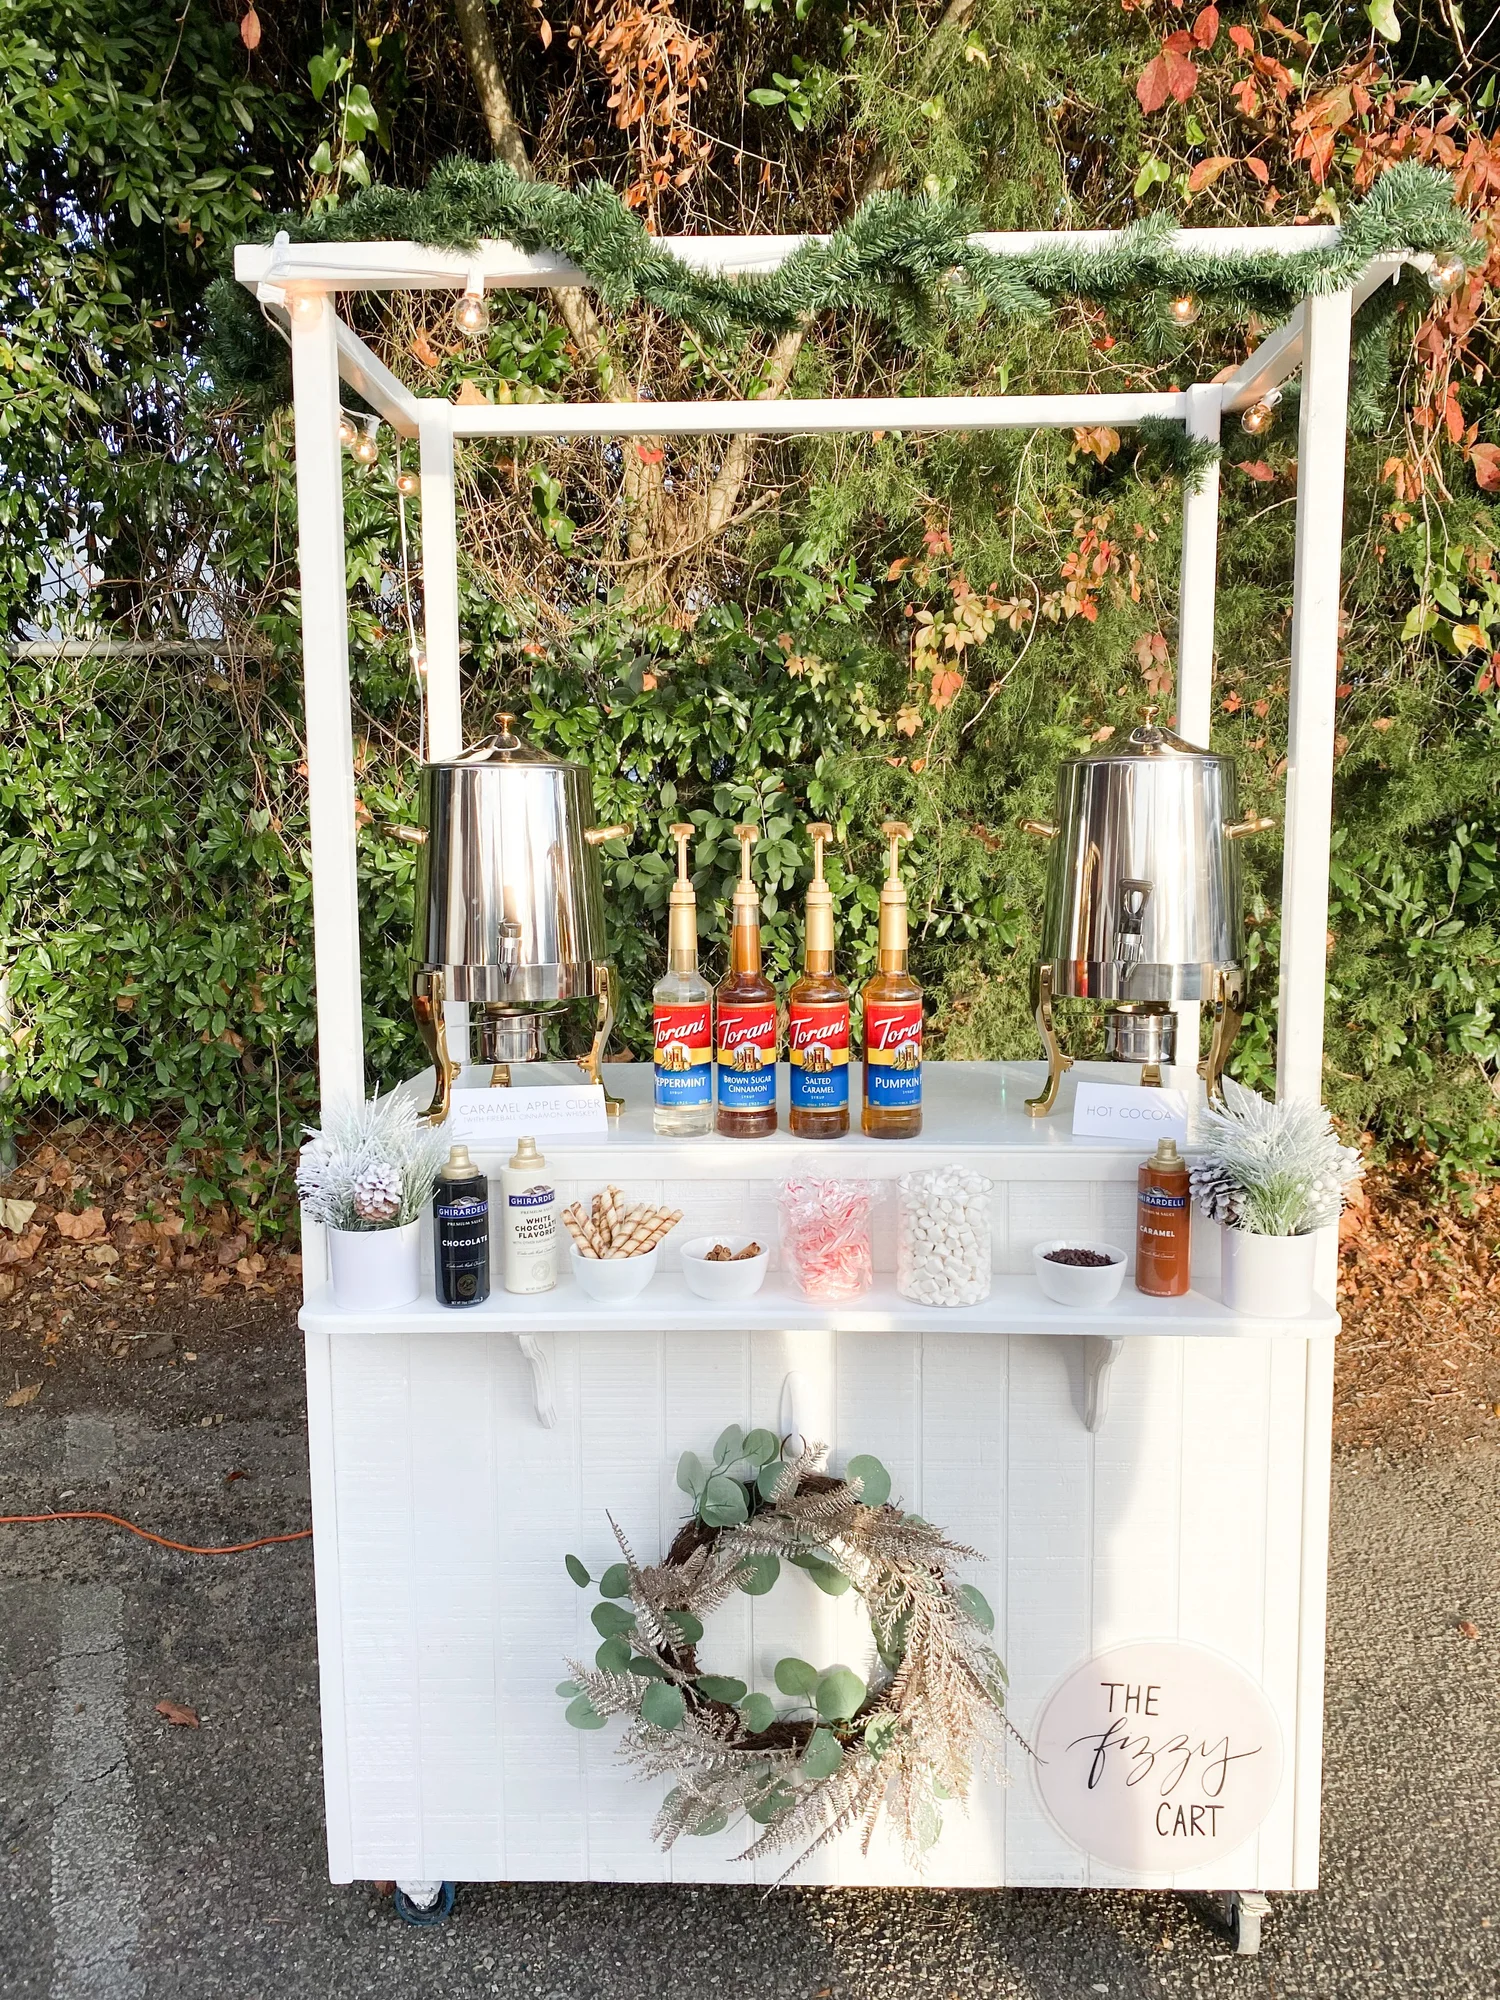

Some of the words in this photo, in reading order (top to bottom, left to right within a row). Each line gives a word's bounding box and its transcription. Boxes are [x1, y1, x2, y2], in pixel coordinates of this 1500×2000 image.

[653, 1014, 706, 1049] Torani
[719, 1014, 774, 1051] Torani
[790, 1014, 846, 1051] Torani
[723, 1075, 749, 1084] BROWN
[750, 1075, 772, 1084] SUGAR
[805, 1076, 831, 1085] SALTED
[875, 1077, 920, 1089] PUMPKIN
[728, 1084, 768, 1093] CINNAMON
[801, 1085, 835, 1093] CARAMEL
[459, 1103, 520, 1116] CARAMEL
[526, 1099, 560, 1111] APPLE
[565, 1098, 601, 1110] CIDER
[1086, 1105, 1113, 1117] HOT
[1119, 1107, 1173, 1121] COCOA
[486, 1114, 517, 1122] FIREBALL
[518, 1111, 563, 1121] CINNAMON
[439, 1202, 488, 1216] GHIRARDELL
[526, 1215, 551, 1225] WHITE
[1140, 1225, 1176, 1237] CARAMEL
[442, 1234, 488, 1247] CHOCOLATE
[1100, 1683, 1161, 1716] THE
[1065, 1717, 1263, 1797] fizzy
[1156, 1802, 1225, 1837] CART
